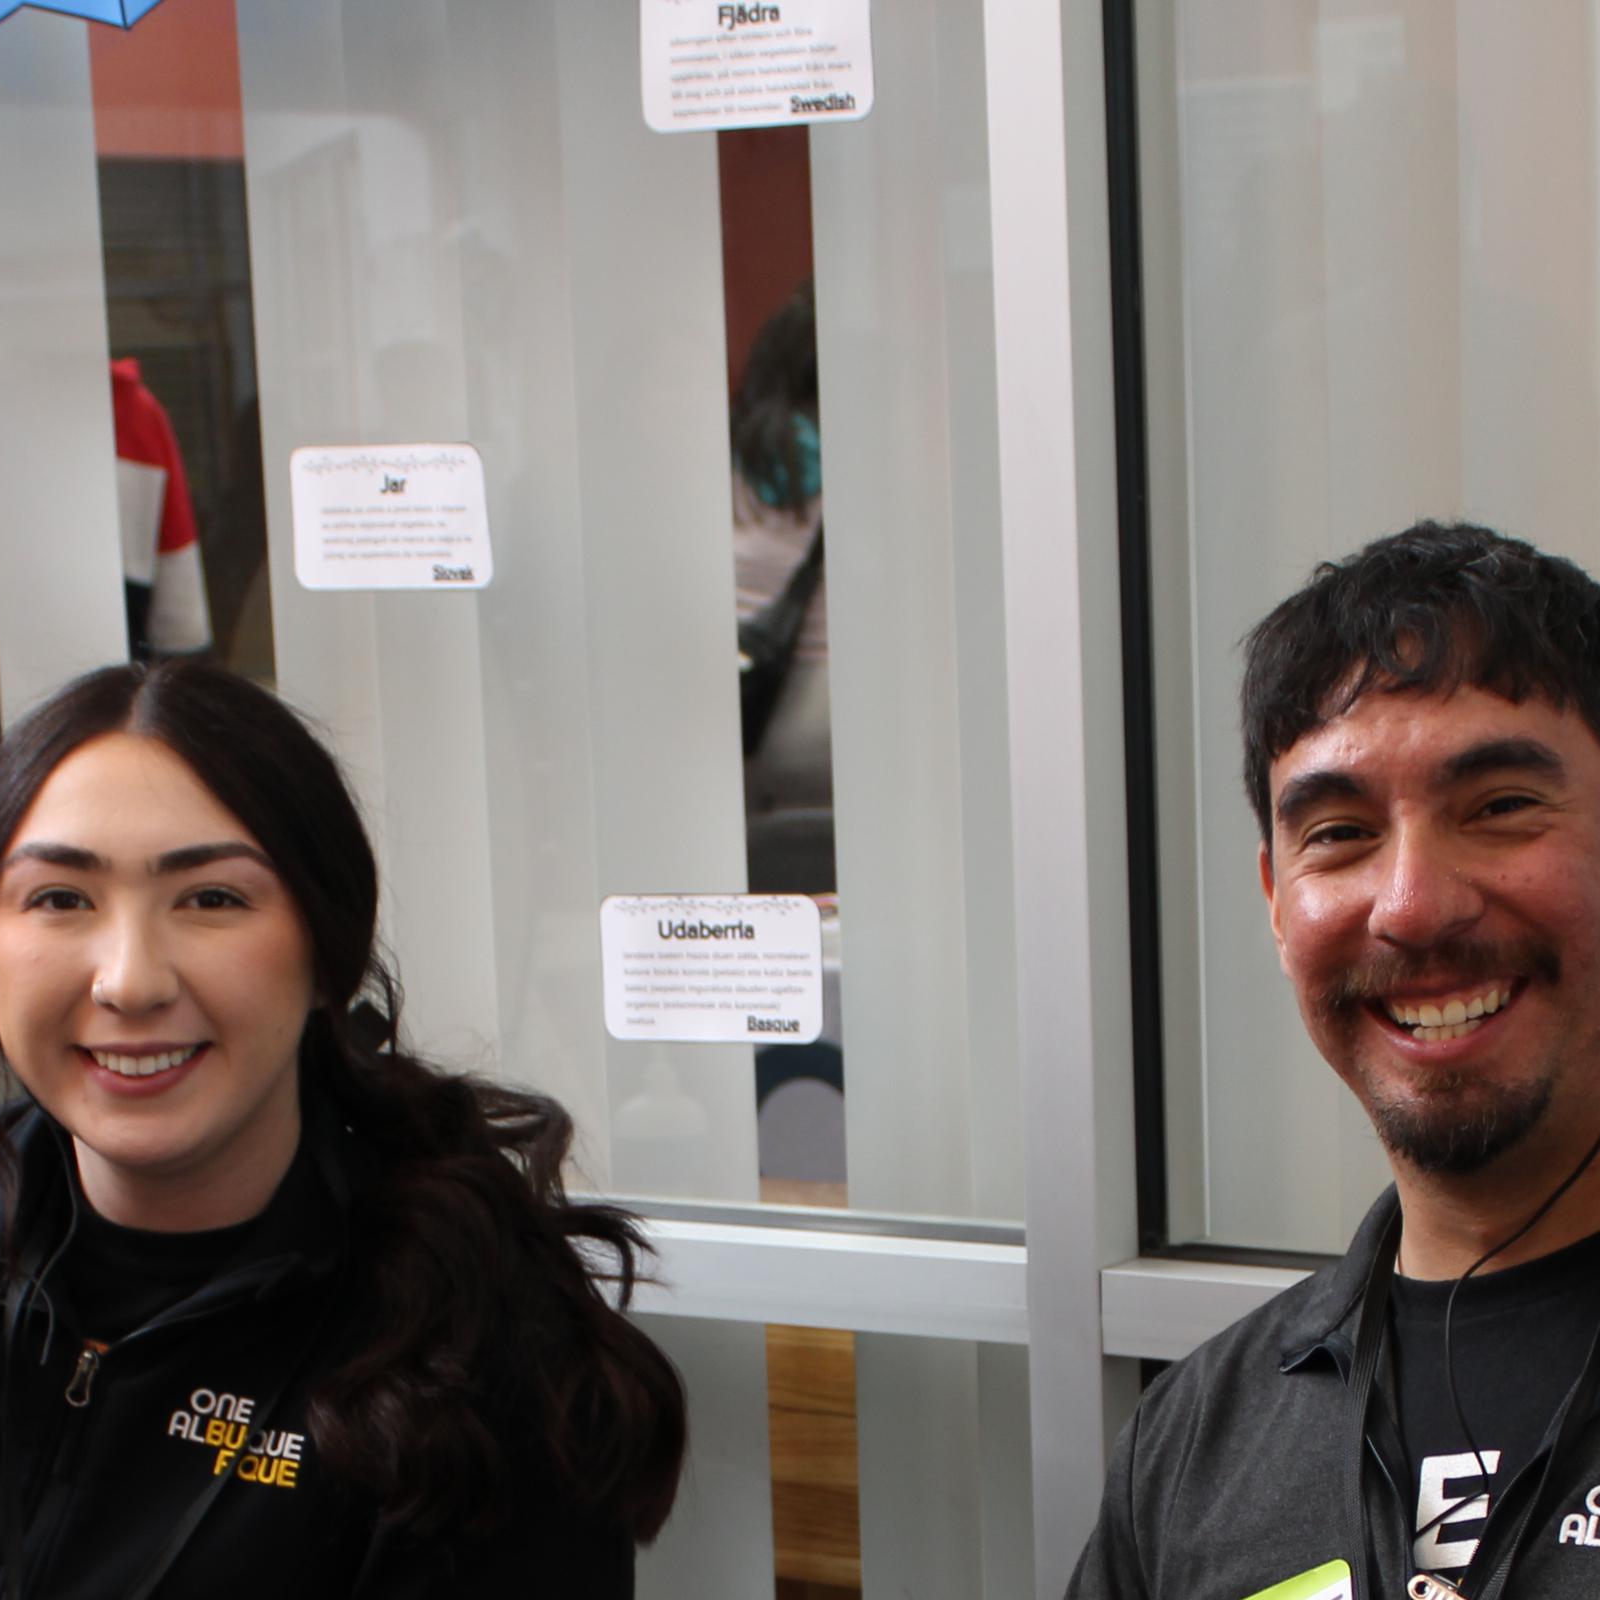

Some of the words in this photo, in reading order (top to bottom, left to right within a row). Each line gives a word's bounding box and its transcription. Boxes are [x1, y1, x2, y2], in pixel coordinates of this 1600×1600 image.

[380, 474, 406, 494] Jar
[657, 920, 756, 940] Udaberria
[747, 1016, 801, 1034] Basque
[190, 1388, 256, 1424] ONE
